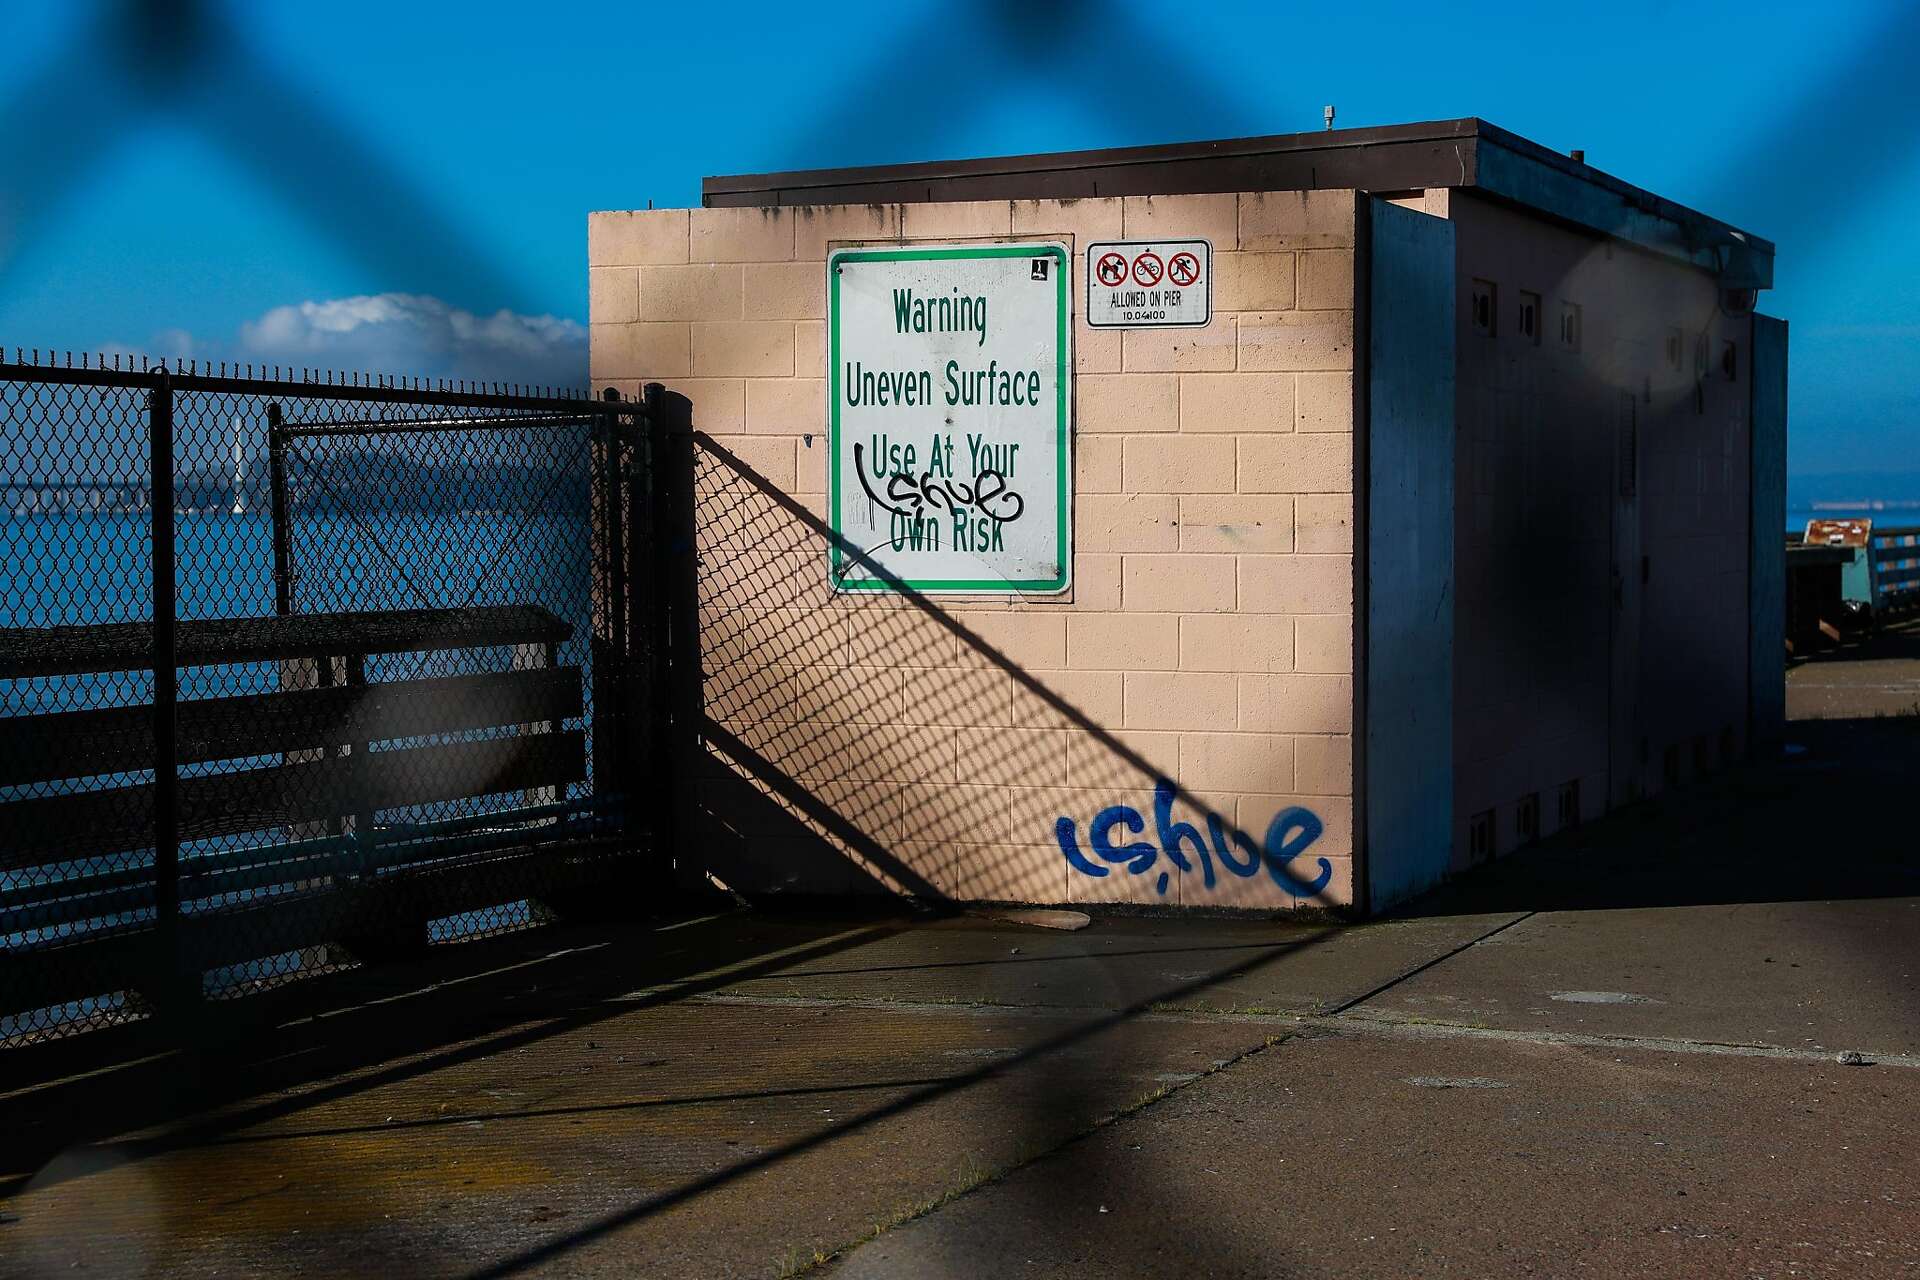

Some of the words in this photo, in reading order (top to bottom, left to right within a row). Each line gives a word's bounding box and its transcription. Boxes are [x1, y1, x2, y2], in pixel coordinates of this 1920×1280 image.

[893, 286, 987, 347] Warning
[1110, 291, 1146, 308] ALLOWED
[1149, 291, 1161, 307] ON
[1164, 290, 1182, 306] PIER
[846, 361, 931, 406] Uneven
[945, 360, 1041, 406] Surface
[872, 433, 917, 479] Use
[928, 433, 954, 479] At
[967, 433, 1020, 479] Your
[890, 506, 940, 553] Own
[952, 507, 1005, 553] Risk
